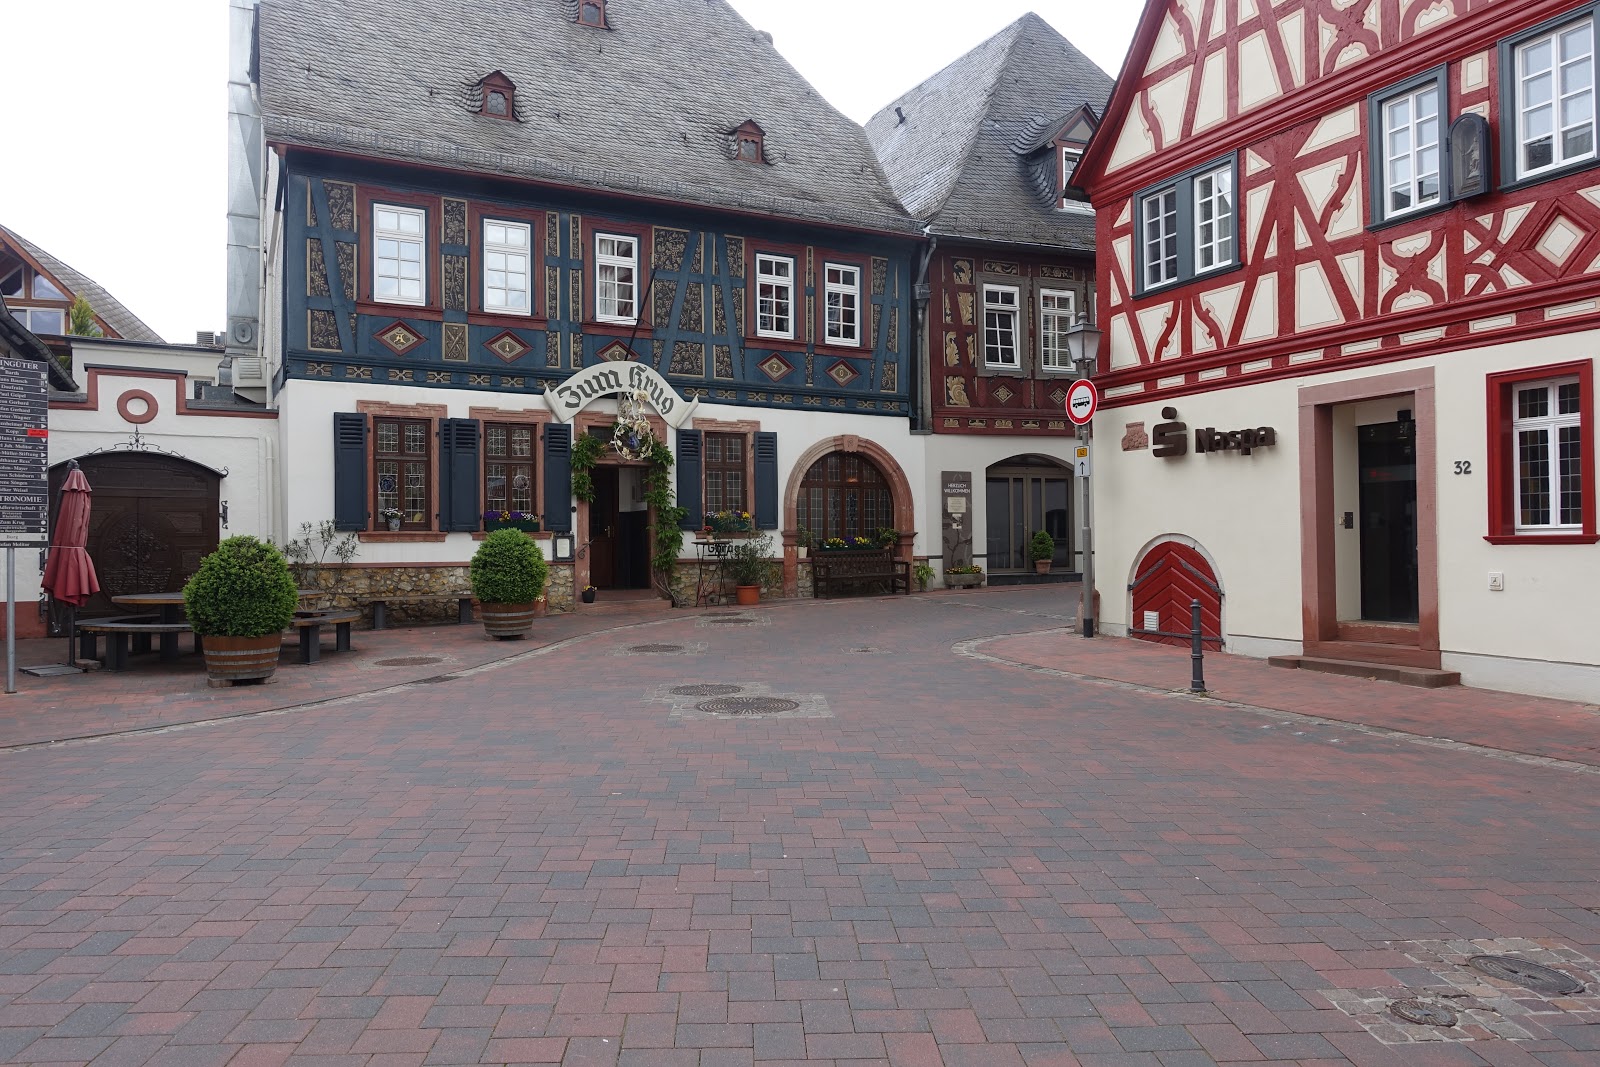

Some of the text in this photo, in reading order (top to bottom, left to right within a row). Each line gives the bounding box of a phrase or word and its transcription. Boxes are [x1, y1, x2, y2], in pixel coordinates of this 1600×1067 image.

[556, 364, 674, 415] Zum Krug
[1195, 426, 1276, 456] Naspa
[1453, 460, 1472, 475] 32
